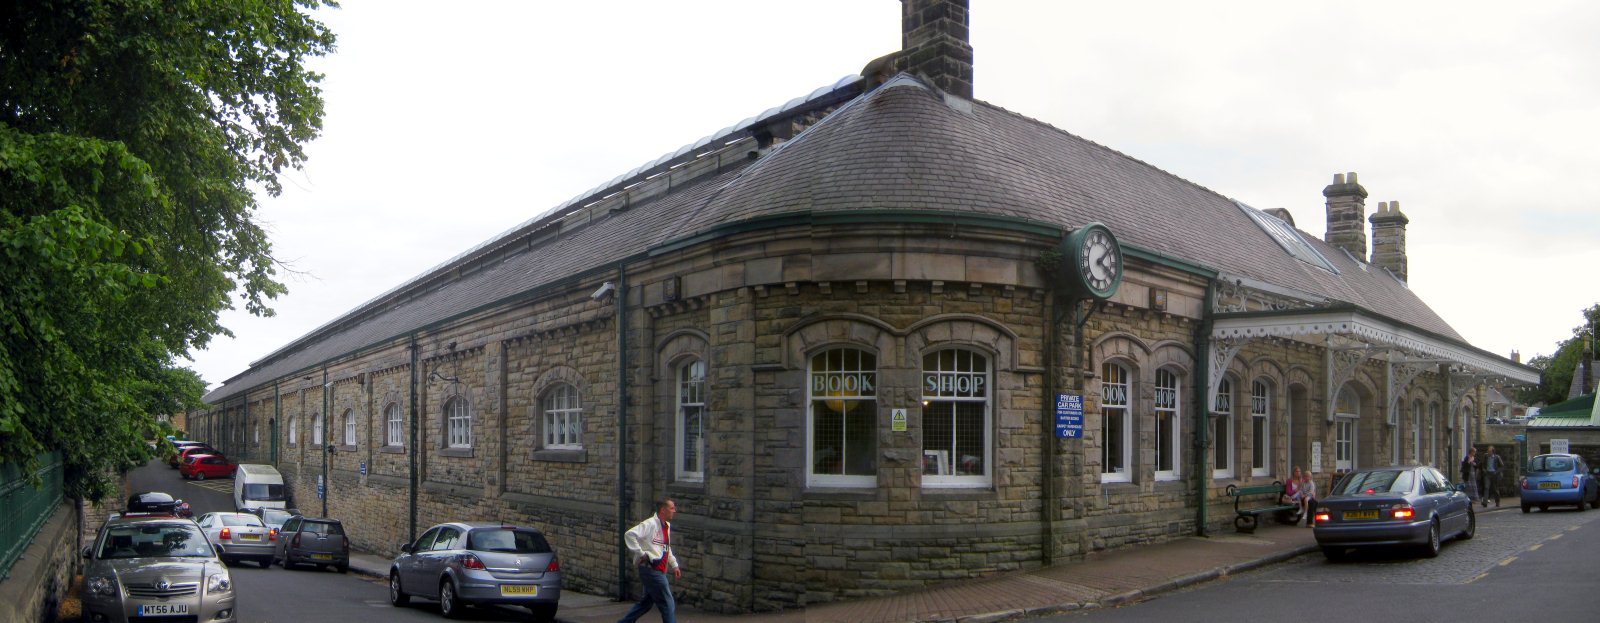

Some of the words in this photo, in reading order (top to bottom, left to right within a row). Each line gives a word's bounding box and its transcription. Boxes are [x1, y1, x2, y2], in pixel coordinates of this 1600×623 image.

[814, 375, 875, 392] BOOK
[925, 376, 985, 393] SHOP
[1102, 386, 1127, 402] OOK
[1155, 390, 1176, 405] HOP
[144, 605, 168, 614] MT56
[170, 604, 187, 614] AJU
